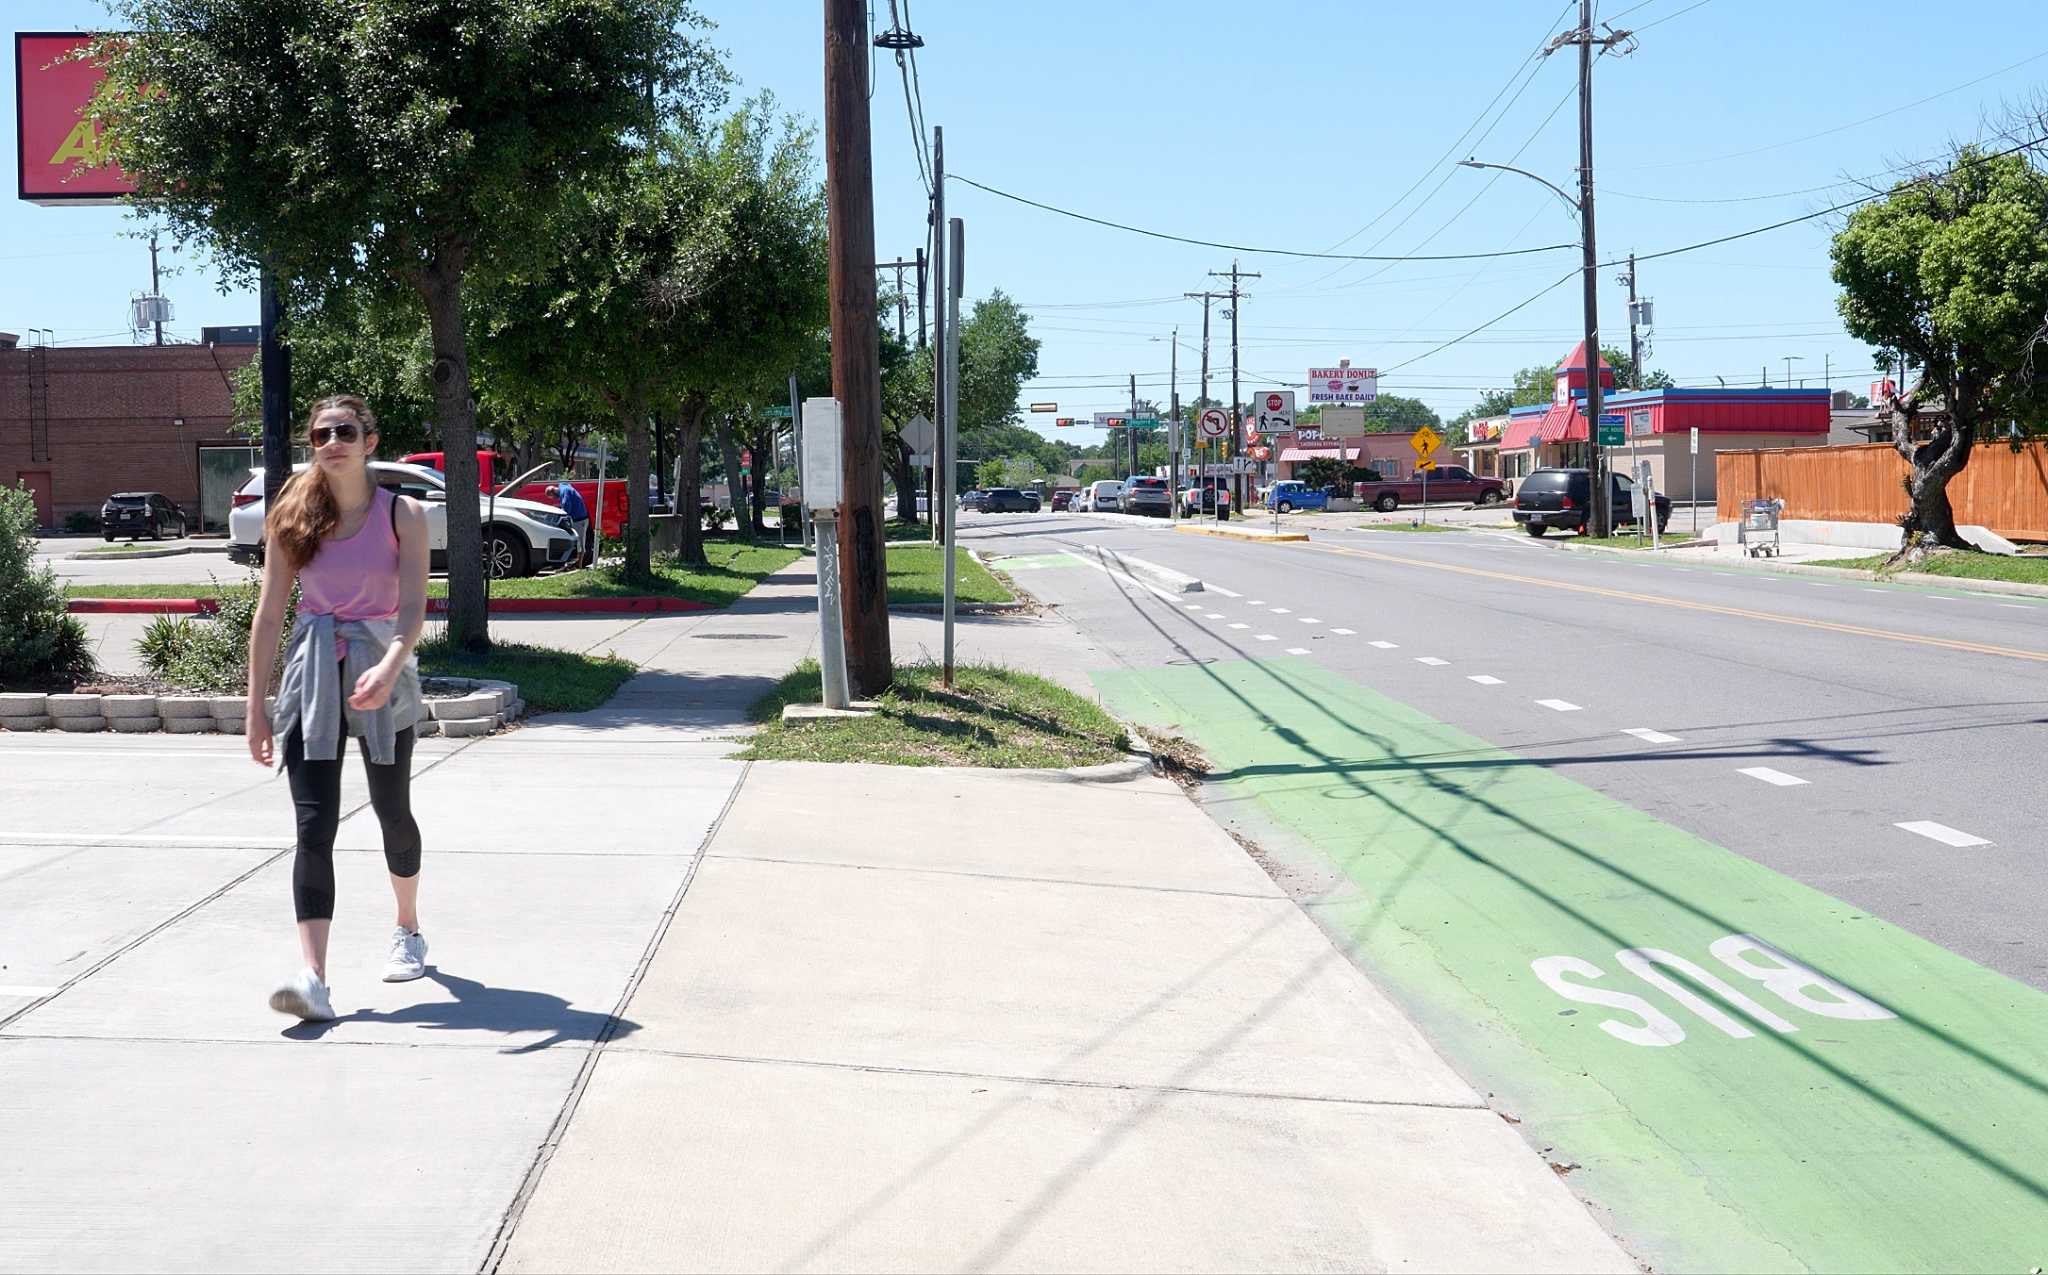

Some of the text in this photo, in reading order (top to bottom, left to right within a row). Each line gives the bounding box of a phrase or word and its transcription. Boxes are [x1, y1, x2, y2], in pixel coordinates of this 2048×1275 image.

[1312, 370, 1376, 379] BAKERY DONUT
[1312, 393, 1376, 401] FRESH BAKE DAILY
[1530, 931, 1899, 1047] BUS
